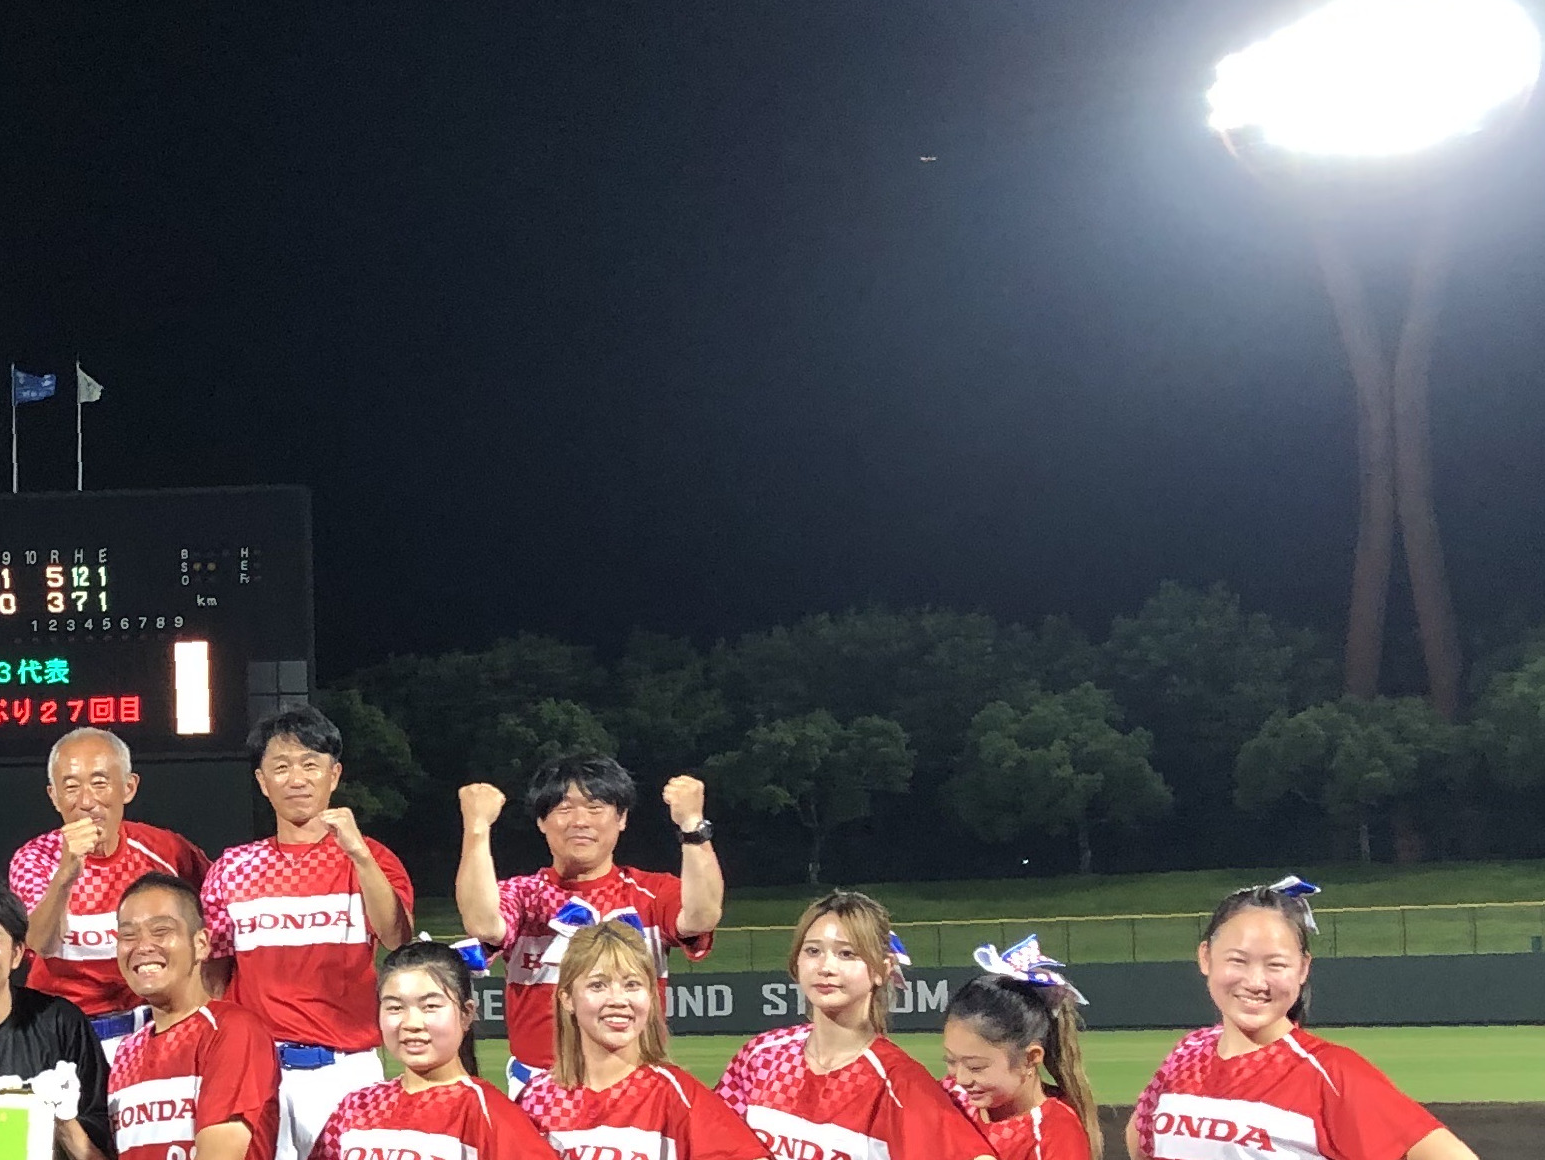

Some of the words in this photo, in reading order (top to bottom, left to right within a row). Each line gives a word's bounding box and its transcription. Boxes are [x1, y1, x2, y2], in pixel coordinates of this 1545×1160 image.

[1, 551, 11, 566] 9
[24, 550, 37, 565] 10
[50, 549, 59, 564] R
[74, 549, 84, 564] H
[98, 547, 107, 563] E
[180, 548, 189, 560] B
[240, 546, 249, 558] H
[180, 561, 189, 573] S
[240, 560, 249, 571] E
[1, 568, 10, 589] 1
[45, 566, 64, 588] 5
[71, 566, 90, 587] 12
[98, 566, 107, 587] 1
[46, 591, 65, 613] 3
[71, 591, 88, 612] 7
[98, 591, 107, 612] 1
[196, 594, 218, 606] km
[31, 619, 38, 632] 1
[48, 619, 58, 631] 2
[66, 619, 76, 632] 3
[84, 618, 94, 630] 4
[102, 617, 111, 631] 5
[120, 617, 130, 630] 6
[138, 616, 148, 629] 7
[156, 616, 166, 629] 8
[174, 616, 184, 628] 9
[235, 910, 357, 935] HONDA
[53, 928, 118, 948] HON
[1152, 1111, 1277, 1153] ONDA
